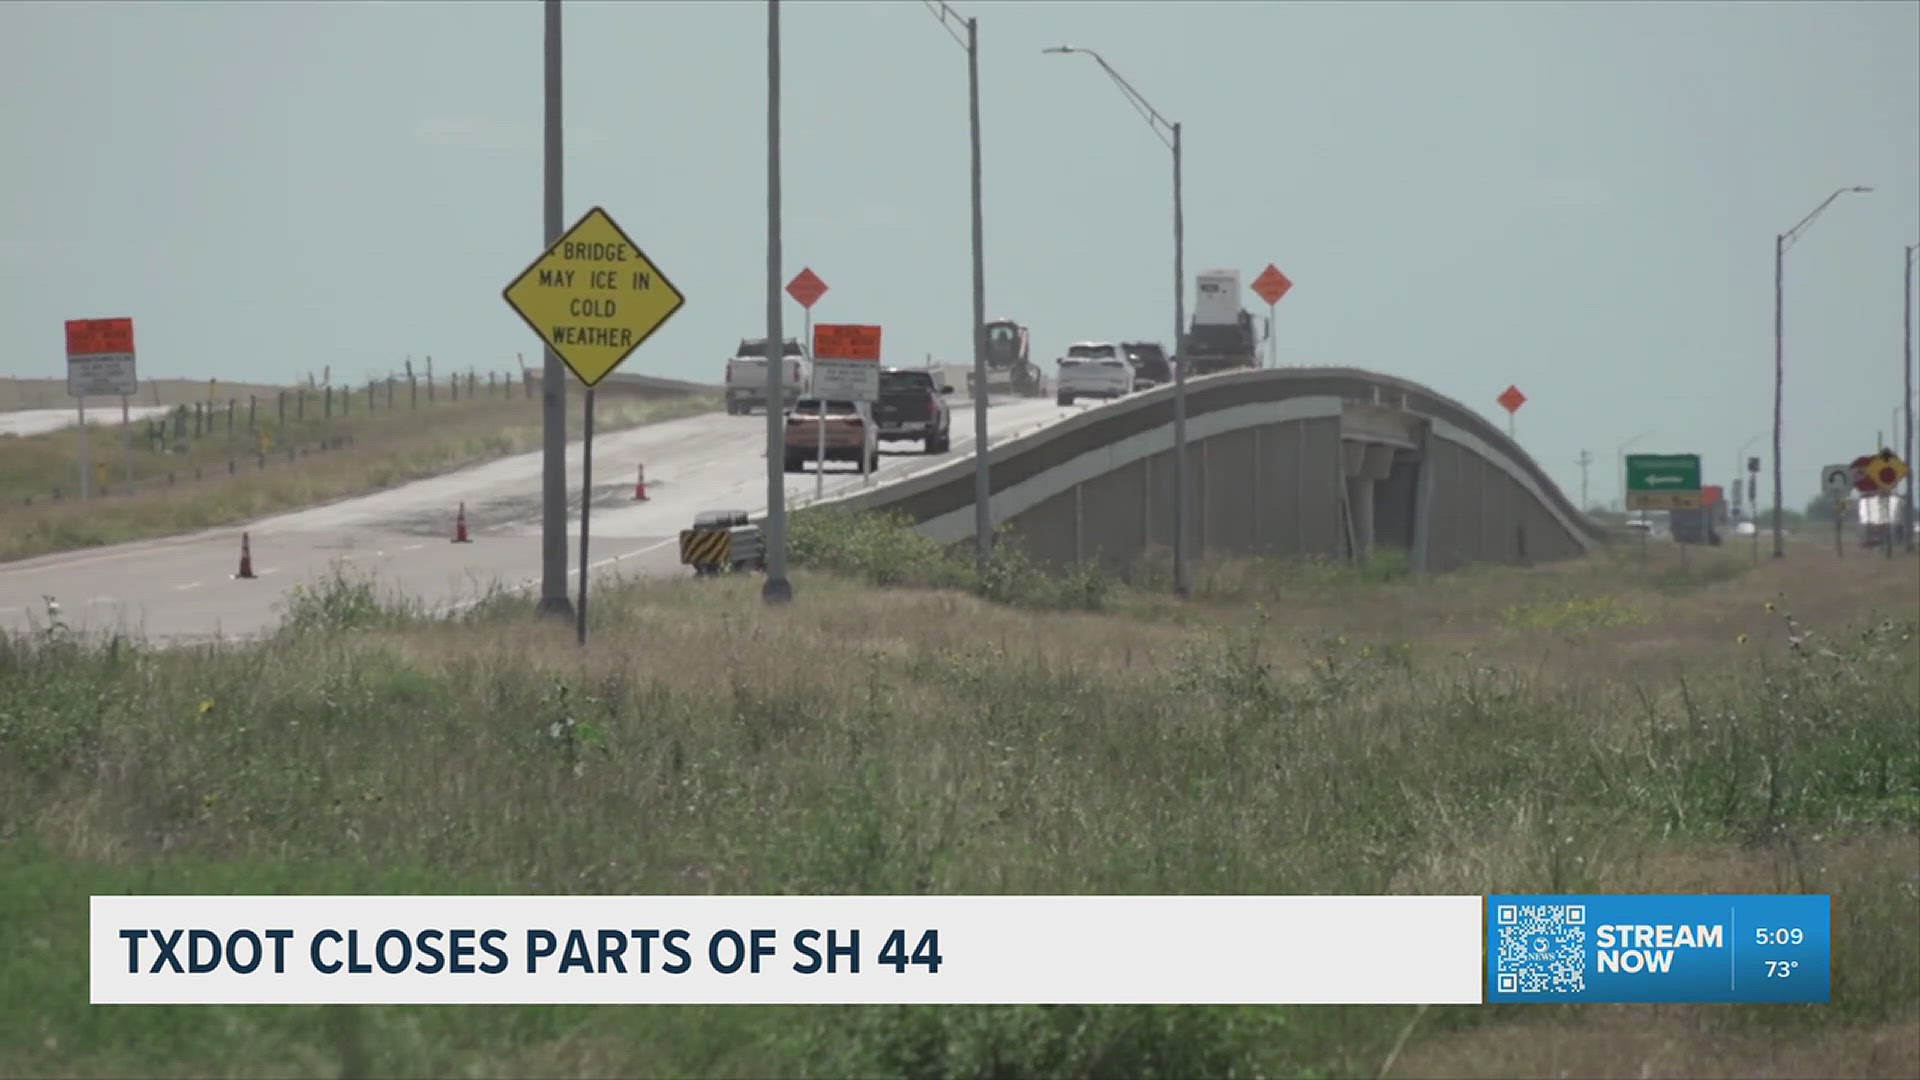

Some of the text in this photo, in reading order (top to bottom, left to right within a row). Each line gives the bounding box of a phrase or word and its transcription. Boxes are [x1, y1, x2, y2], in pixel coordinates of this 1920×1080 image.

[564, 242, 627, 261] BRIDGE
[539, 270, 650, 290] MAY ICE IN
[570, 299, 617, 318] COLD
[552, 326, 632, 347] WEATHER
